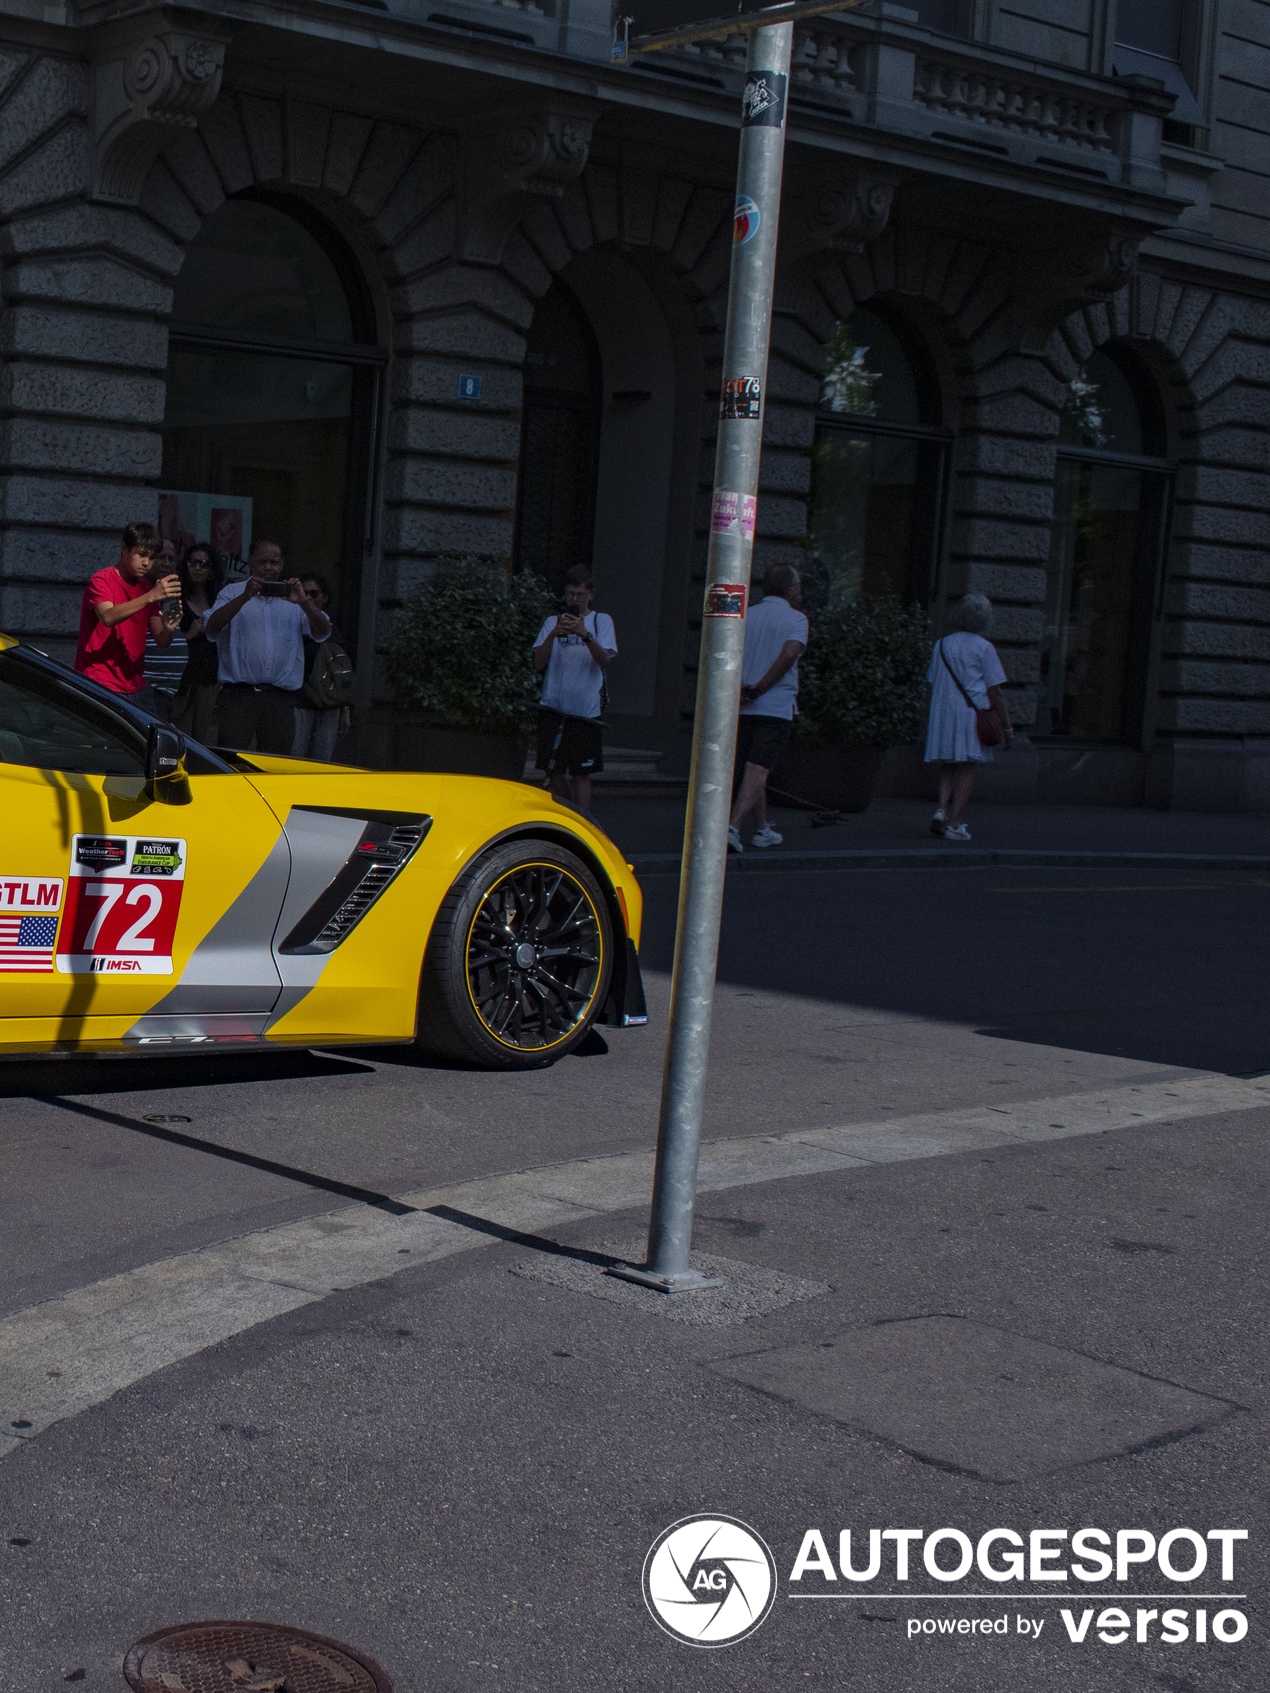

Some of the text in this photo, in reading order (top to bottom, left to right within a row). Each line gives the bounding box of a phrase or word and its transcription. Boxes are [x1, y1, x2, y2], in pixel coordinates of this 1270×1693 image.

[466, 379, 474, 395] 8
[78, 847, 125, 856] WeatherTech
[142, 845, 172, 855] PATRÓN
[82, 882, 163, 952] 72
[106, 960, 142, 971] IMSA
